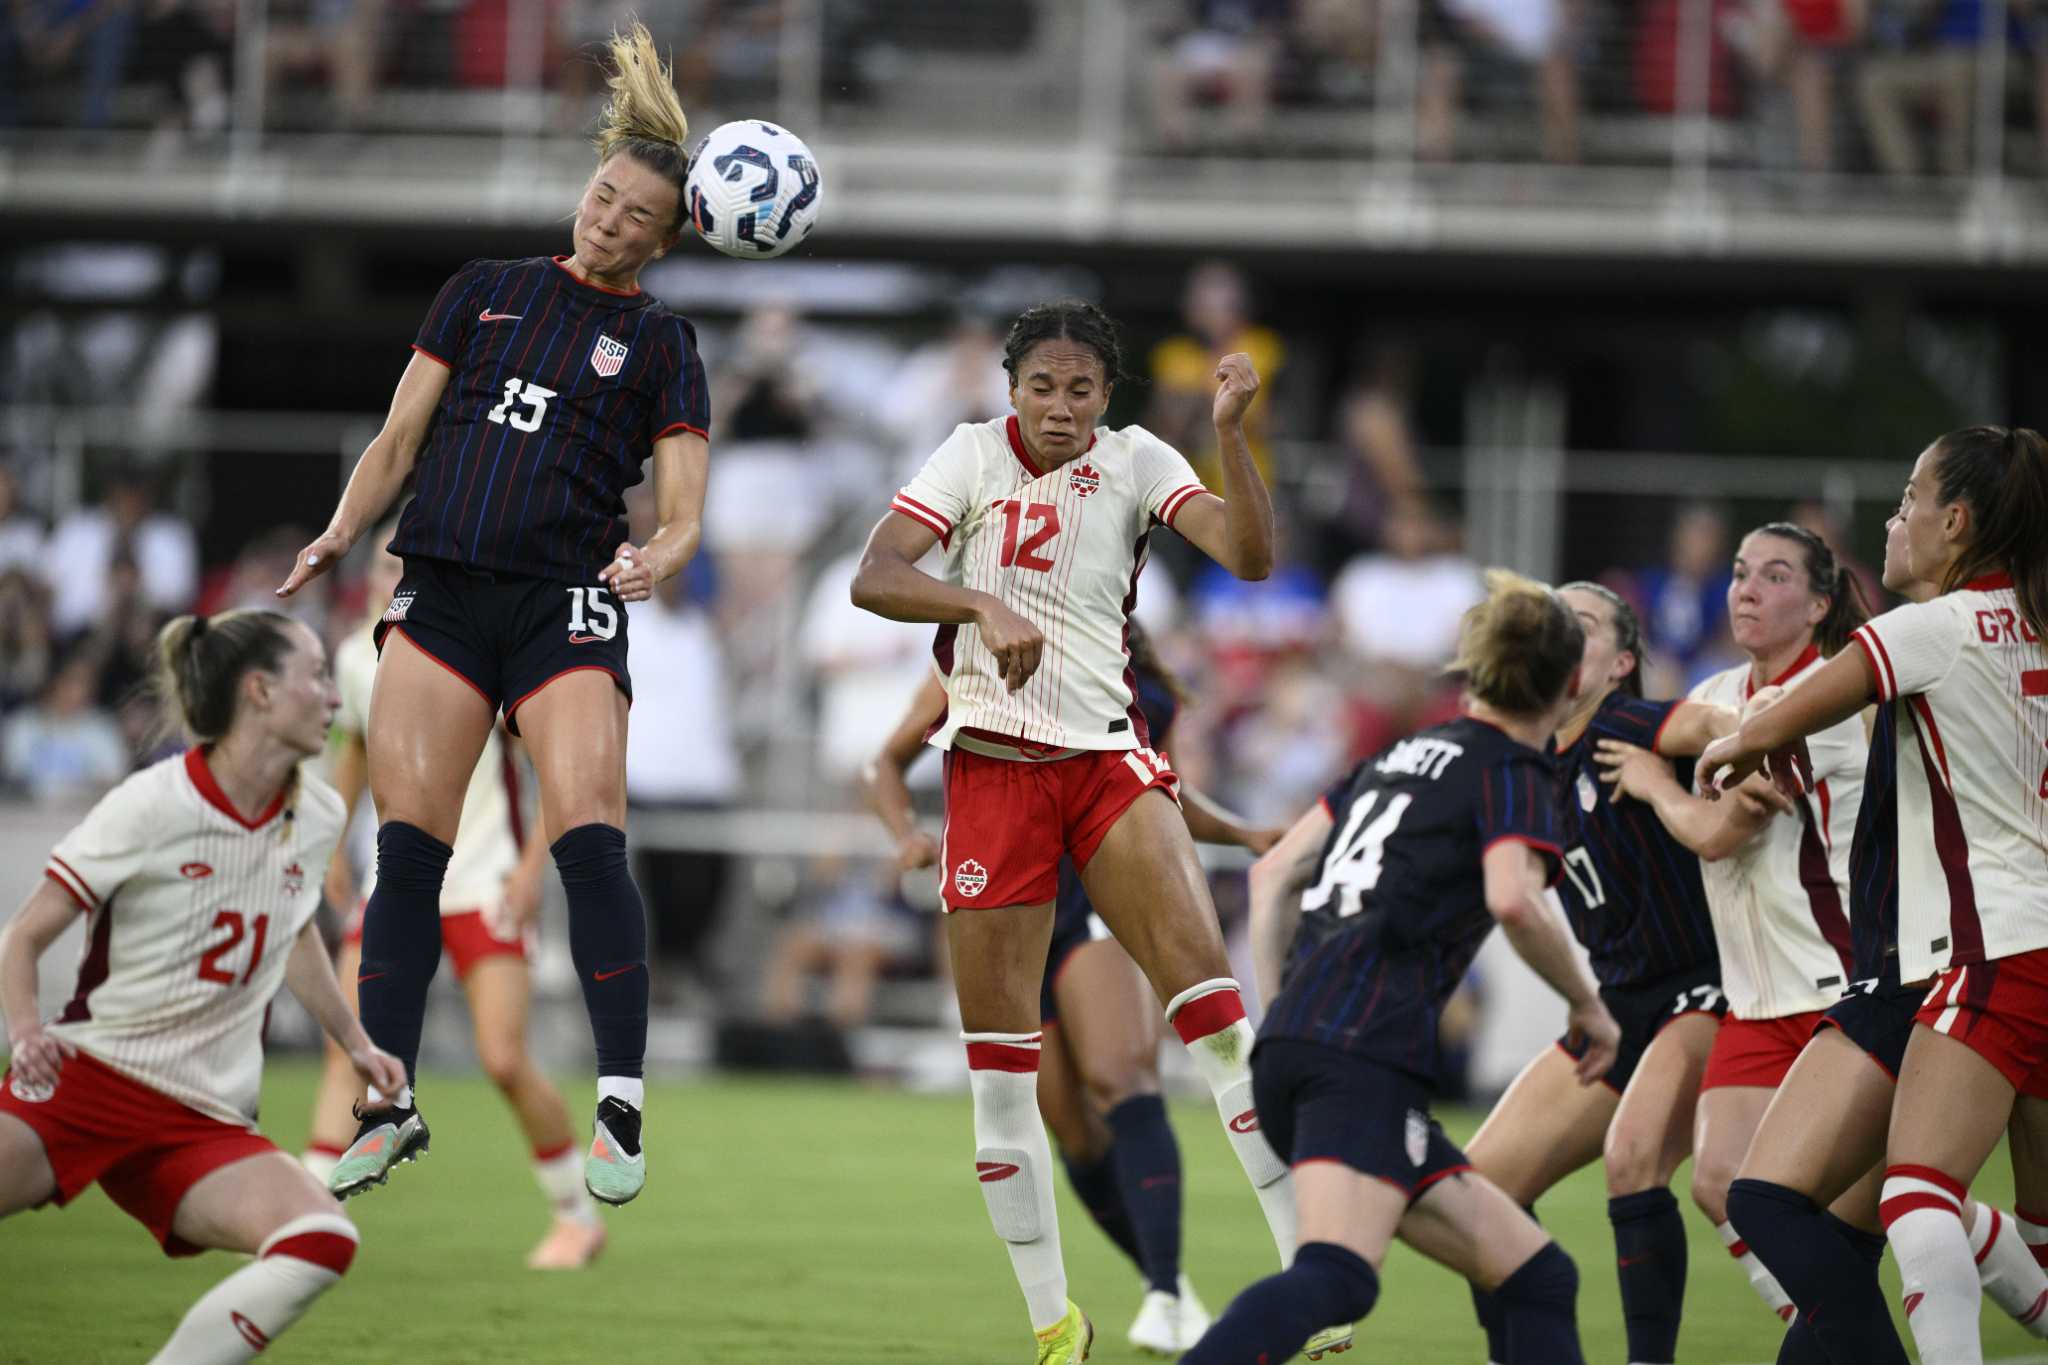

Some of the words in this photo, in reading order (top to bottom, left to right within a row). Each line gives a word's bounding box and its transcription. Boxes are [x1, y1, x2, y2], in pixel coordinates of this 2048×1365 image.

[599, 337, 627, 358] USA
[488, 377, 558, 433] 15
[1070, 475, 1100, 487] CANADA
[1000, 500, 1061, 573] 12
[566, 587, 618, 641] 15
[1301, 790, 1412, 917] 14
[1562, 846, 1606, 910] 17
[198, 911, 269, 987] 21
